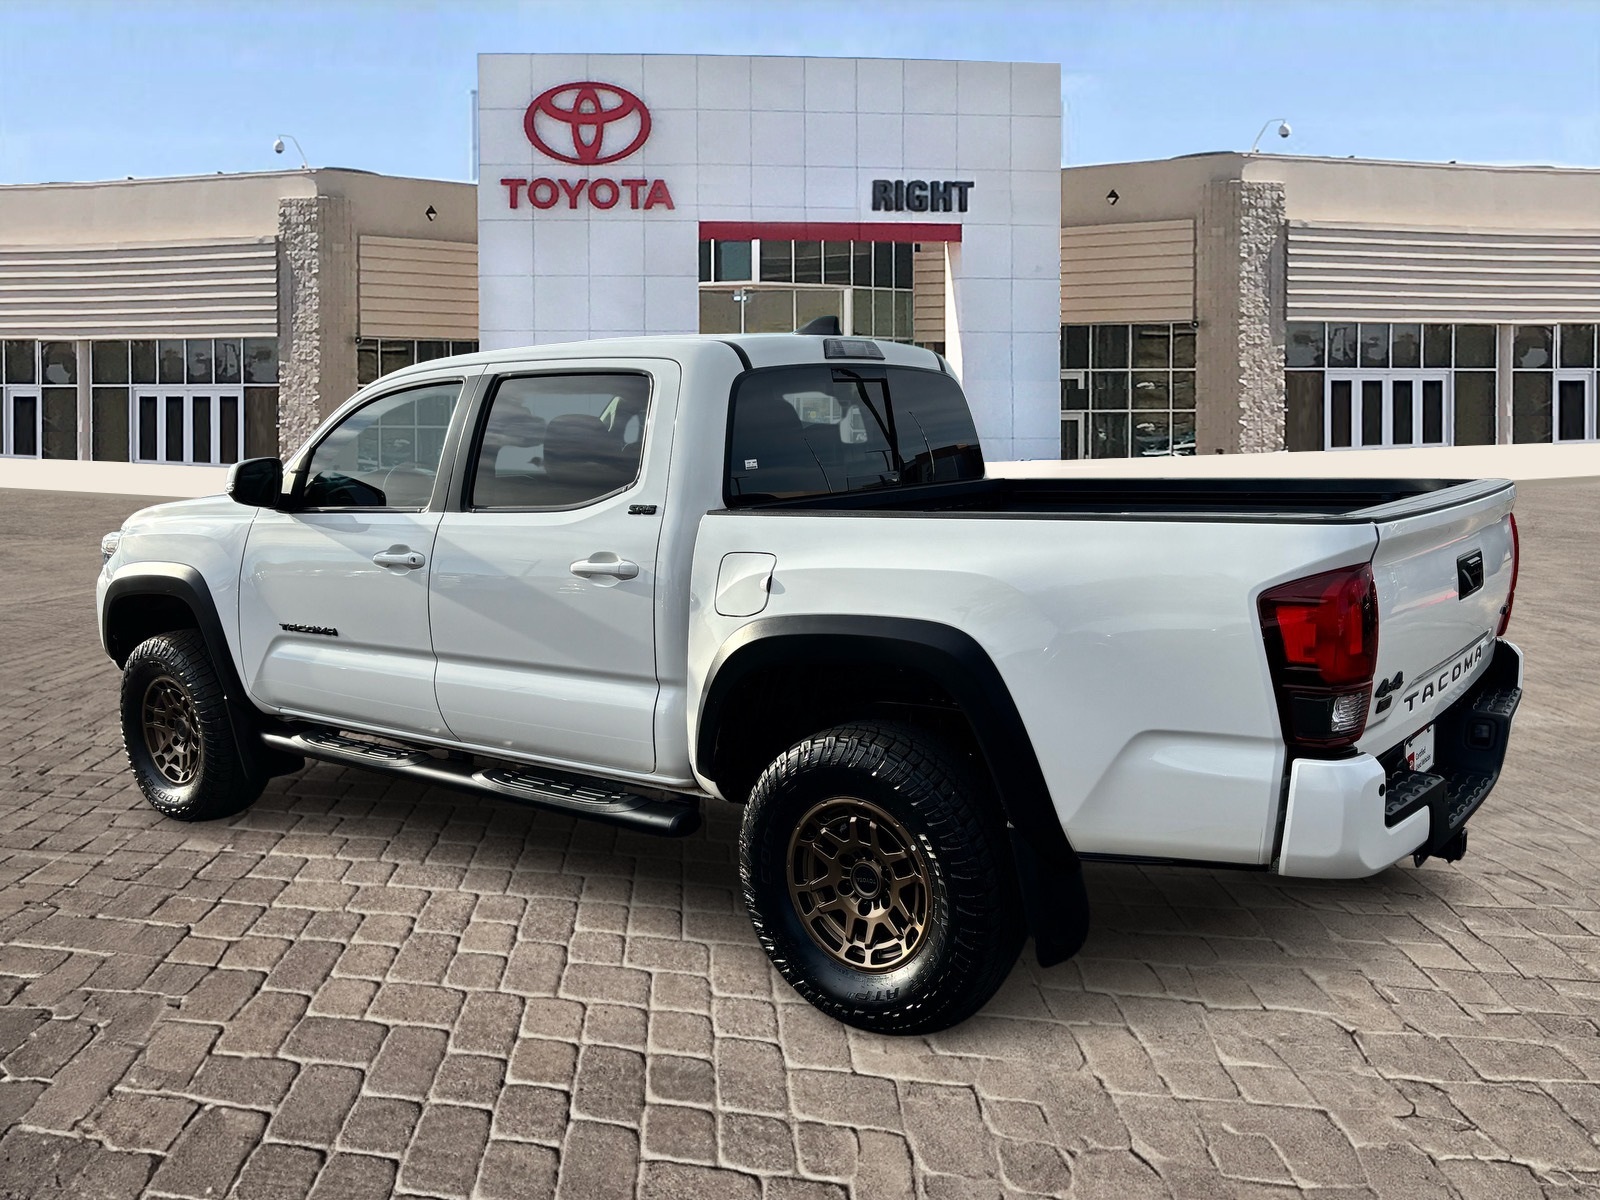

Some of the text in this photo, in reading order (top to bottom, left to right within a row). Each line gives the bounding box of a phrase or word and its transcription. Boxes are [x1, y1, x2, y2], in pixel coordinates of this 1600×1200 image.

[500, 177, 675, 210] TOYOTA
[871, 178, 975, 213] RIGHT
[1403, 644, 1483, 713] TACOMA
